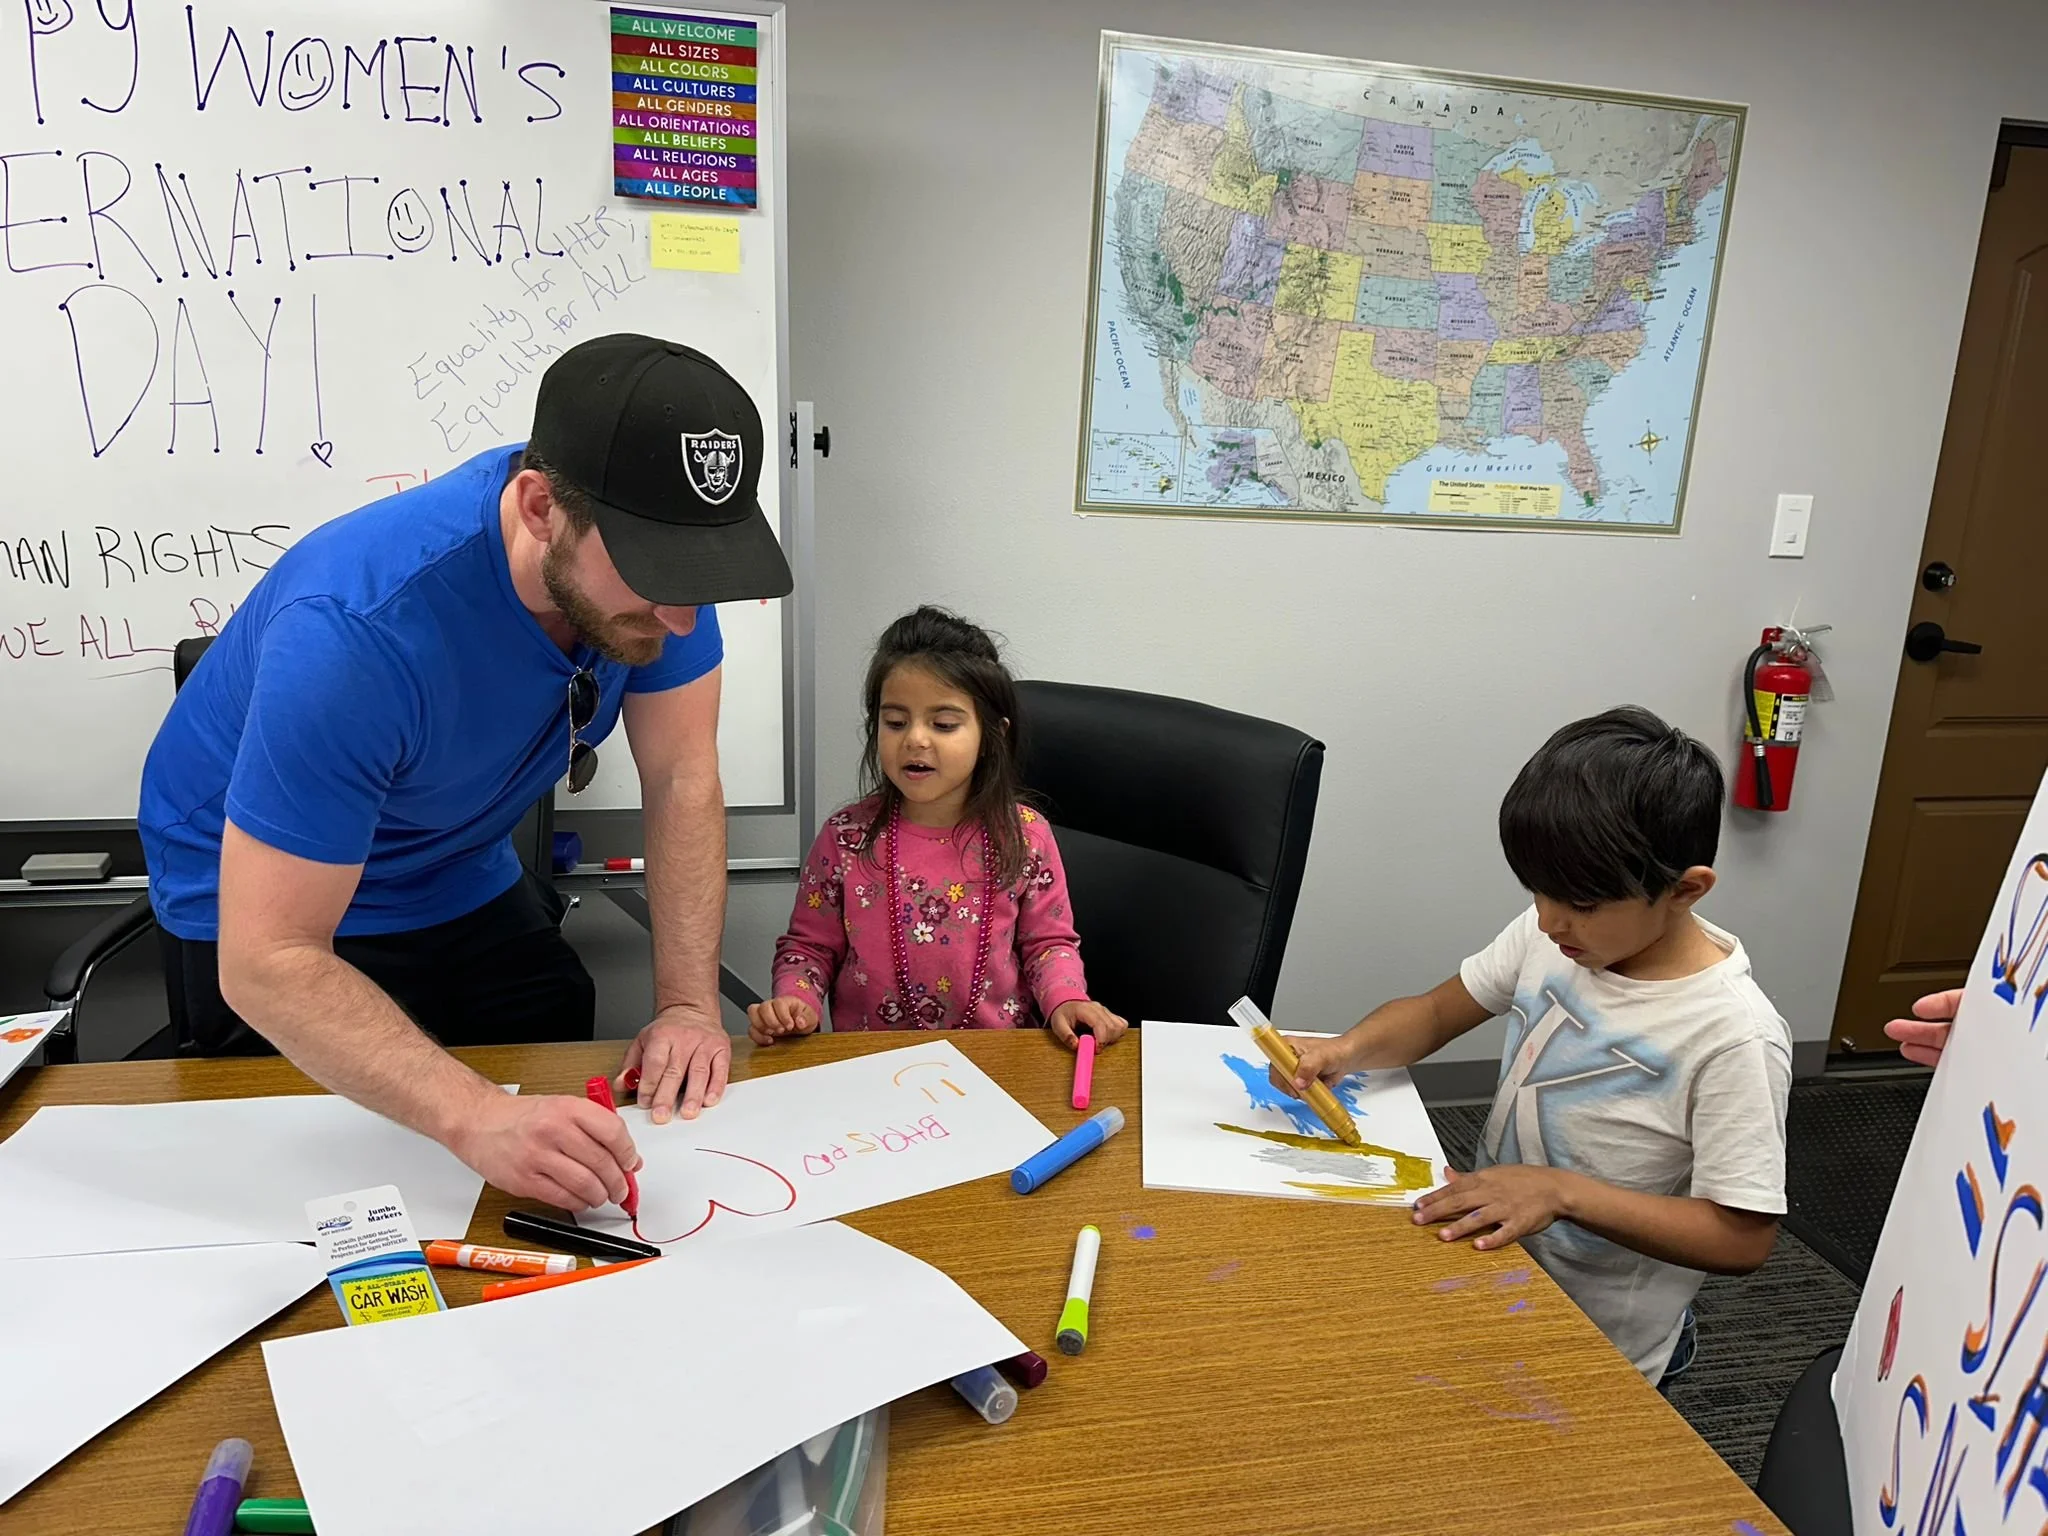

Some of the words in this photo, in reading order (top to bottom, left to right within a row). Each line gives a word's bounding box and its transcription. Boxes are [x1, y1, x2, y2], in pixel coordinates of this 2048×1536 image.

[632, 20, 658, 34] ALL
[662, 22, 736, 41] WELCOME
[649, 42, 674, 56] ALL
[679, 44, 720, 60] SIZES
[640, 60, 665, 73] ALL
[670, 62, 728, 79] COLORS
[634, 78, 658, 91] ALL
[662, 80, 736, 98] CULTURES
[637, 97, 662, 110] ALL
[666, 100, 732, 116] GENDERS
[619, 114, 644, 126] ALL
[648, 116, 750, 136] ORIENTATIONS
[644, 132, 668, 144] ALL
[673, 134, 726, 150] BELIEFS
[634, 149, 658, 161] ALL
[663, 152, 736, 168] RELIGIONS
[652, 167, 677, 180] ALL
[682, 170, 718, 182] AGES
[645, 183, 670, 194] ALL
[674, 185, 726, 200] PEOPLE
[545, 300, 578, 335] for
[582, 254, 646, 312] ALL
[408, 304, 534, 400] Equality
[512, 257, 556, 302] for
[1664, 322, 1684, 362] ATLANTIC
[1682, 287, 1698, 317] OCEAN
[1107, 320, 1122, 356] PACIFIC
[1116, 358, 1131, 388] OCEAN
[691, 440, 736, 450] RAIDERS
[1306, 472, 1346, 483] MEXICO
[95, 524, 291, 589] RIGHTS
[79, 614, 175, 661] ALL
[368, 1205, 396, 1216] Jumbo
[368, 1211, 402, 1223] Markers
[331, 1250, 354, 1260] Projects
[338, 1243, 358, 1252] Perfect
[473, 1251, 515, 1268] EXPO
[351, 1292, 384, 1310] CAR
[386, 1284, 429, 1304] WASH
